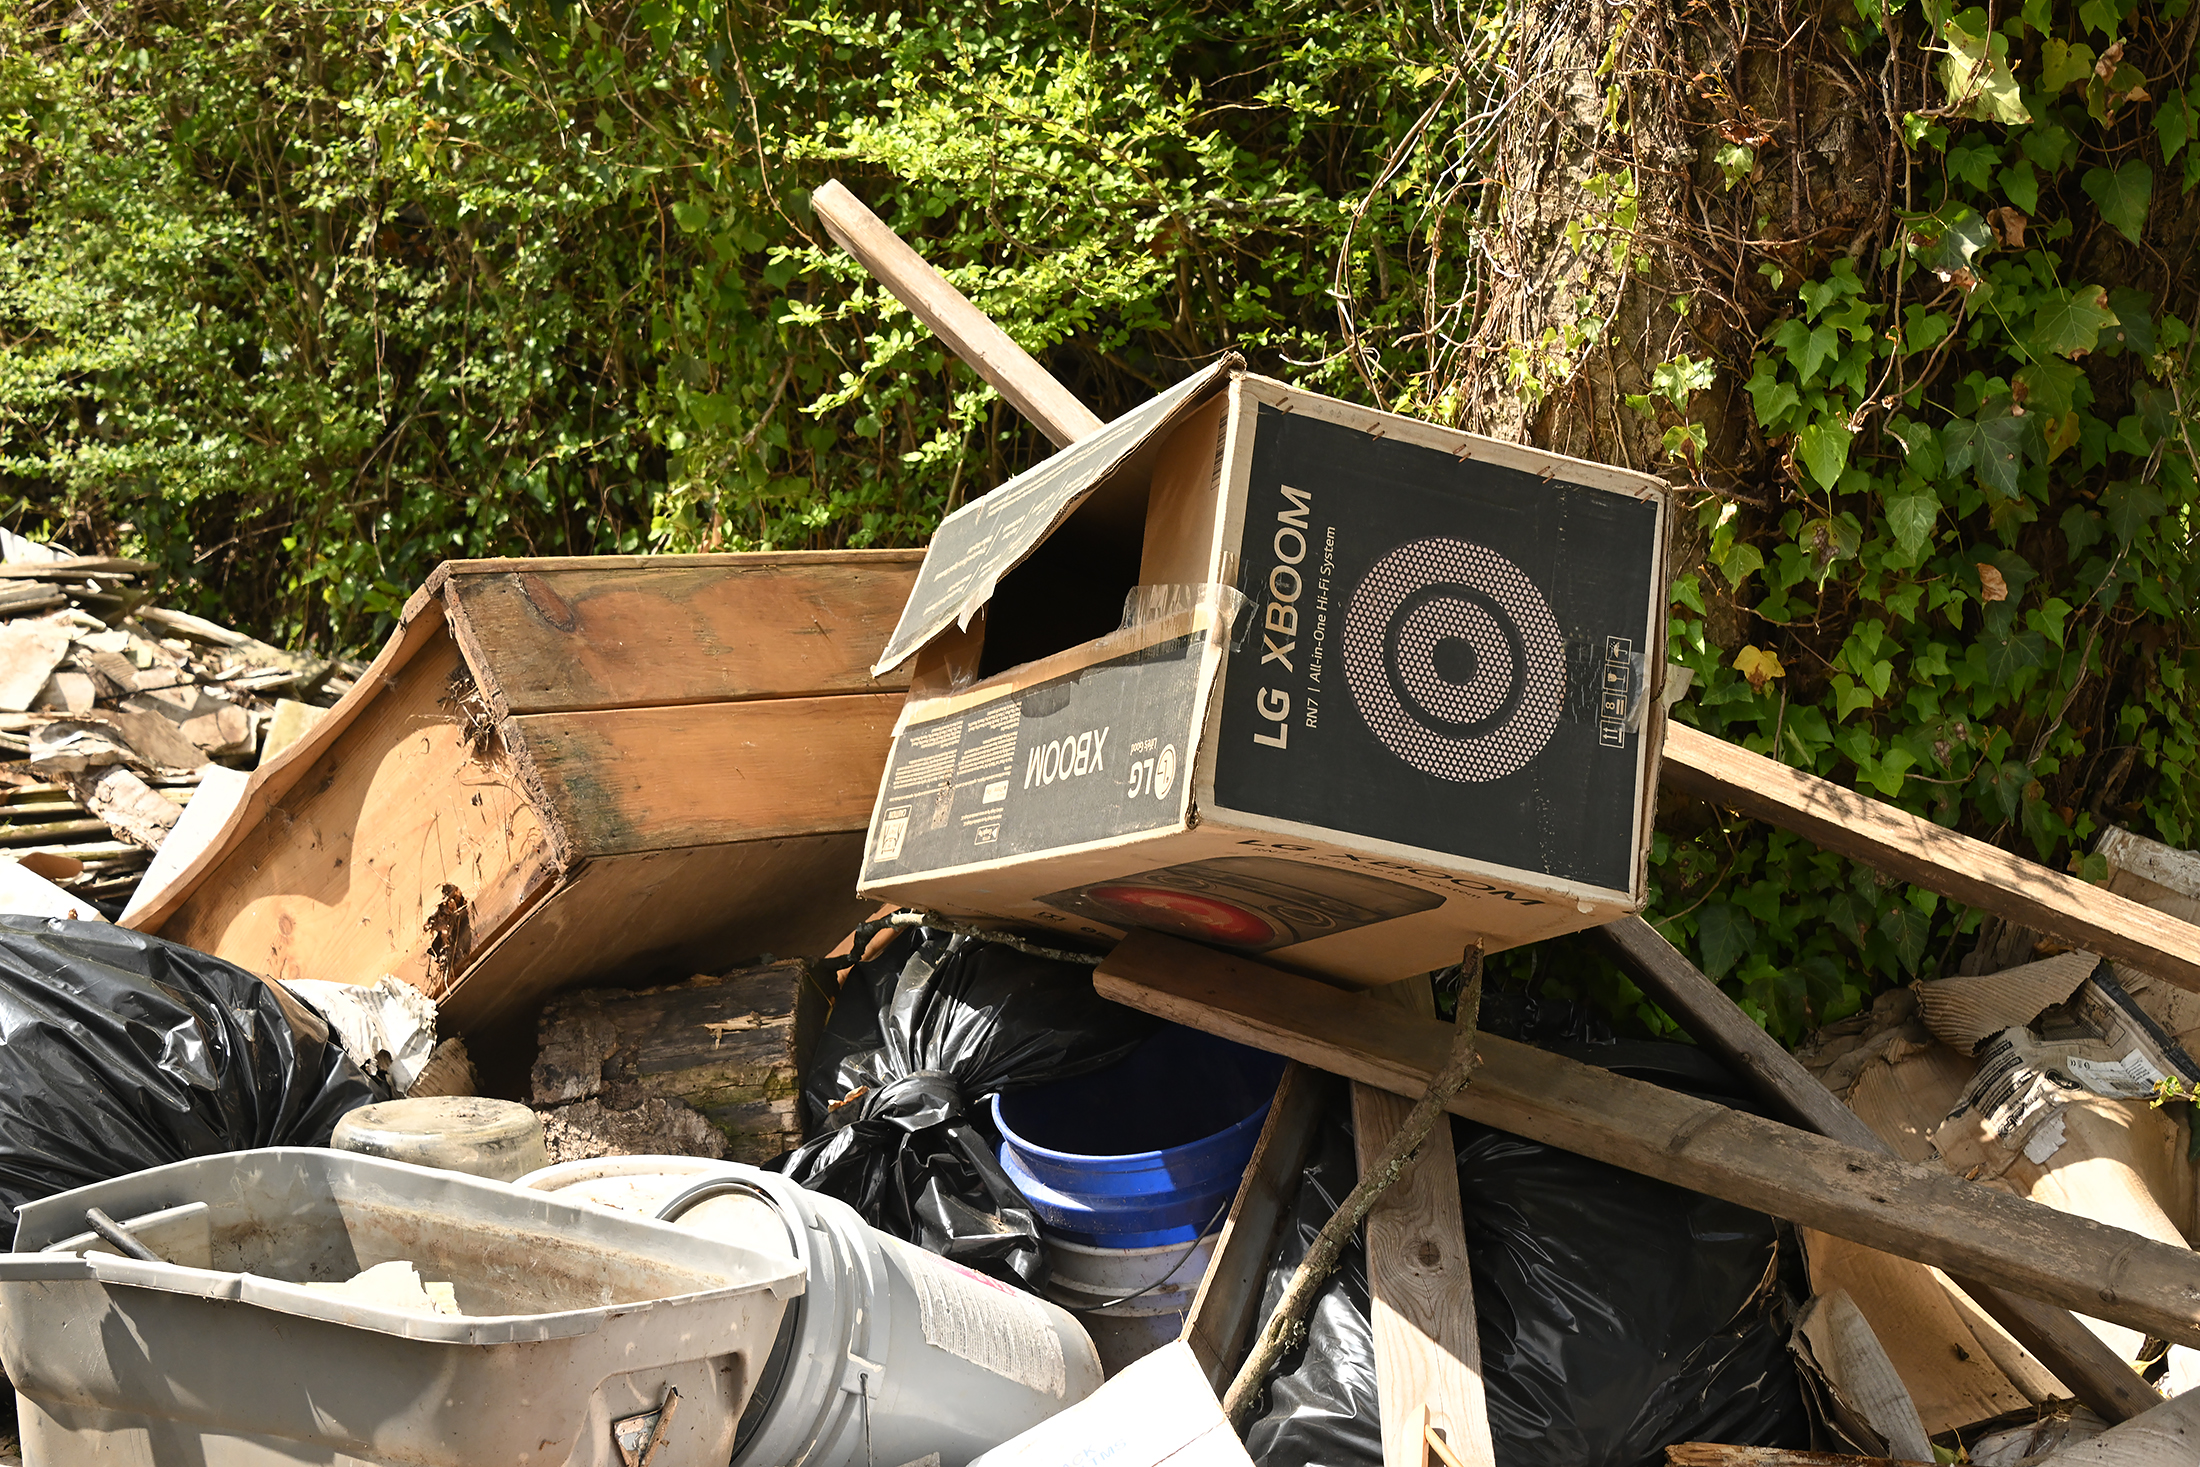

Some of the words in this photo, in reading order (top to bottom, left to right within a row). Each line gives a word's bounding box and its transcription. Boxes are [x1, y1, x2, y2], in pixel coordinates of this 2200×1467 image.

[1260, 484, 1312, 673] XBOOM
[1320, 526, 1336, 576] System
[1316, 578, 1331, 611] Hi-Fi
[1309, 613, 1328, 684] All-in-One
[1253, 686, 1291, 750] LG
[1305, 697, 1319, 729] RN7
[1024, 726, 1109, 790] XBOOM
[1130, 741, 1144, 756] Good
[1237, 839, 1315, 851] LG
[1326, 853, 1546, 906] XBOOM
